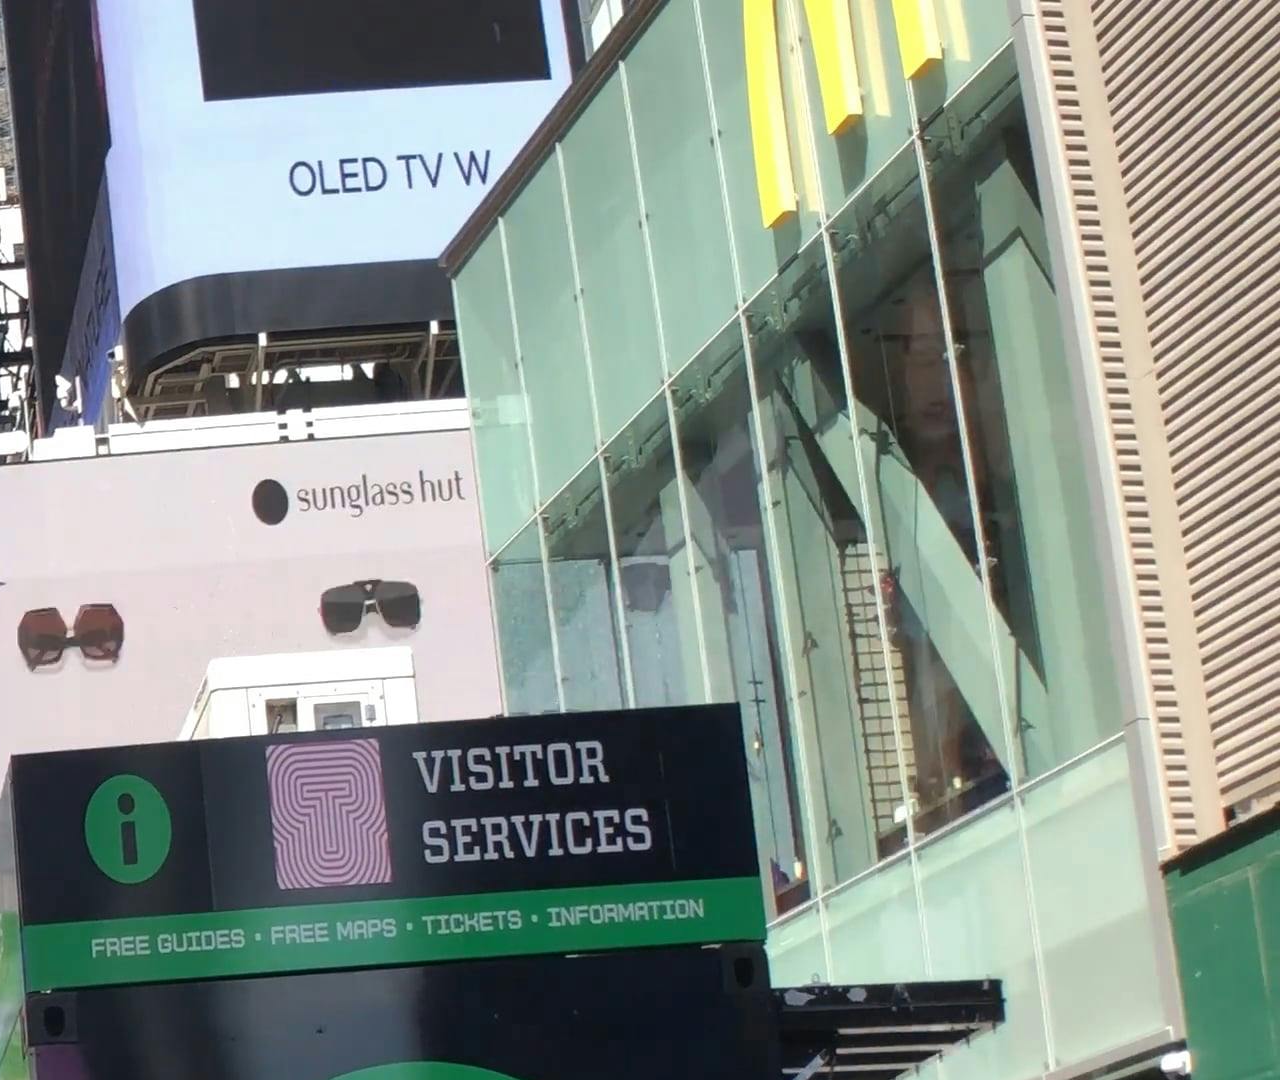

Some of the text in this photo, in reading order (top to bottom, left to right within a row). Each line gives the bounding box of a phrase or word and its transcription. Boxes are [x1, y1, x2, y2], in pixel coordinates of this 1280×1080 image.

[289, 150, 491, 197] OLED TV W
[296, 470, 466, 518] sunglass hut
[413, 741, 609, 794] VISITOR
[421, 807, 652, 863] SERVICES
[91, 899, 704, 958] FREE GUIDES FREE MAPS TICKETS INFORMATION
